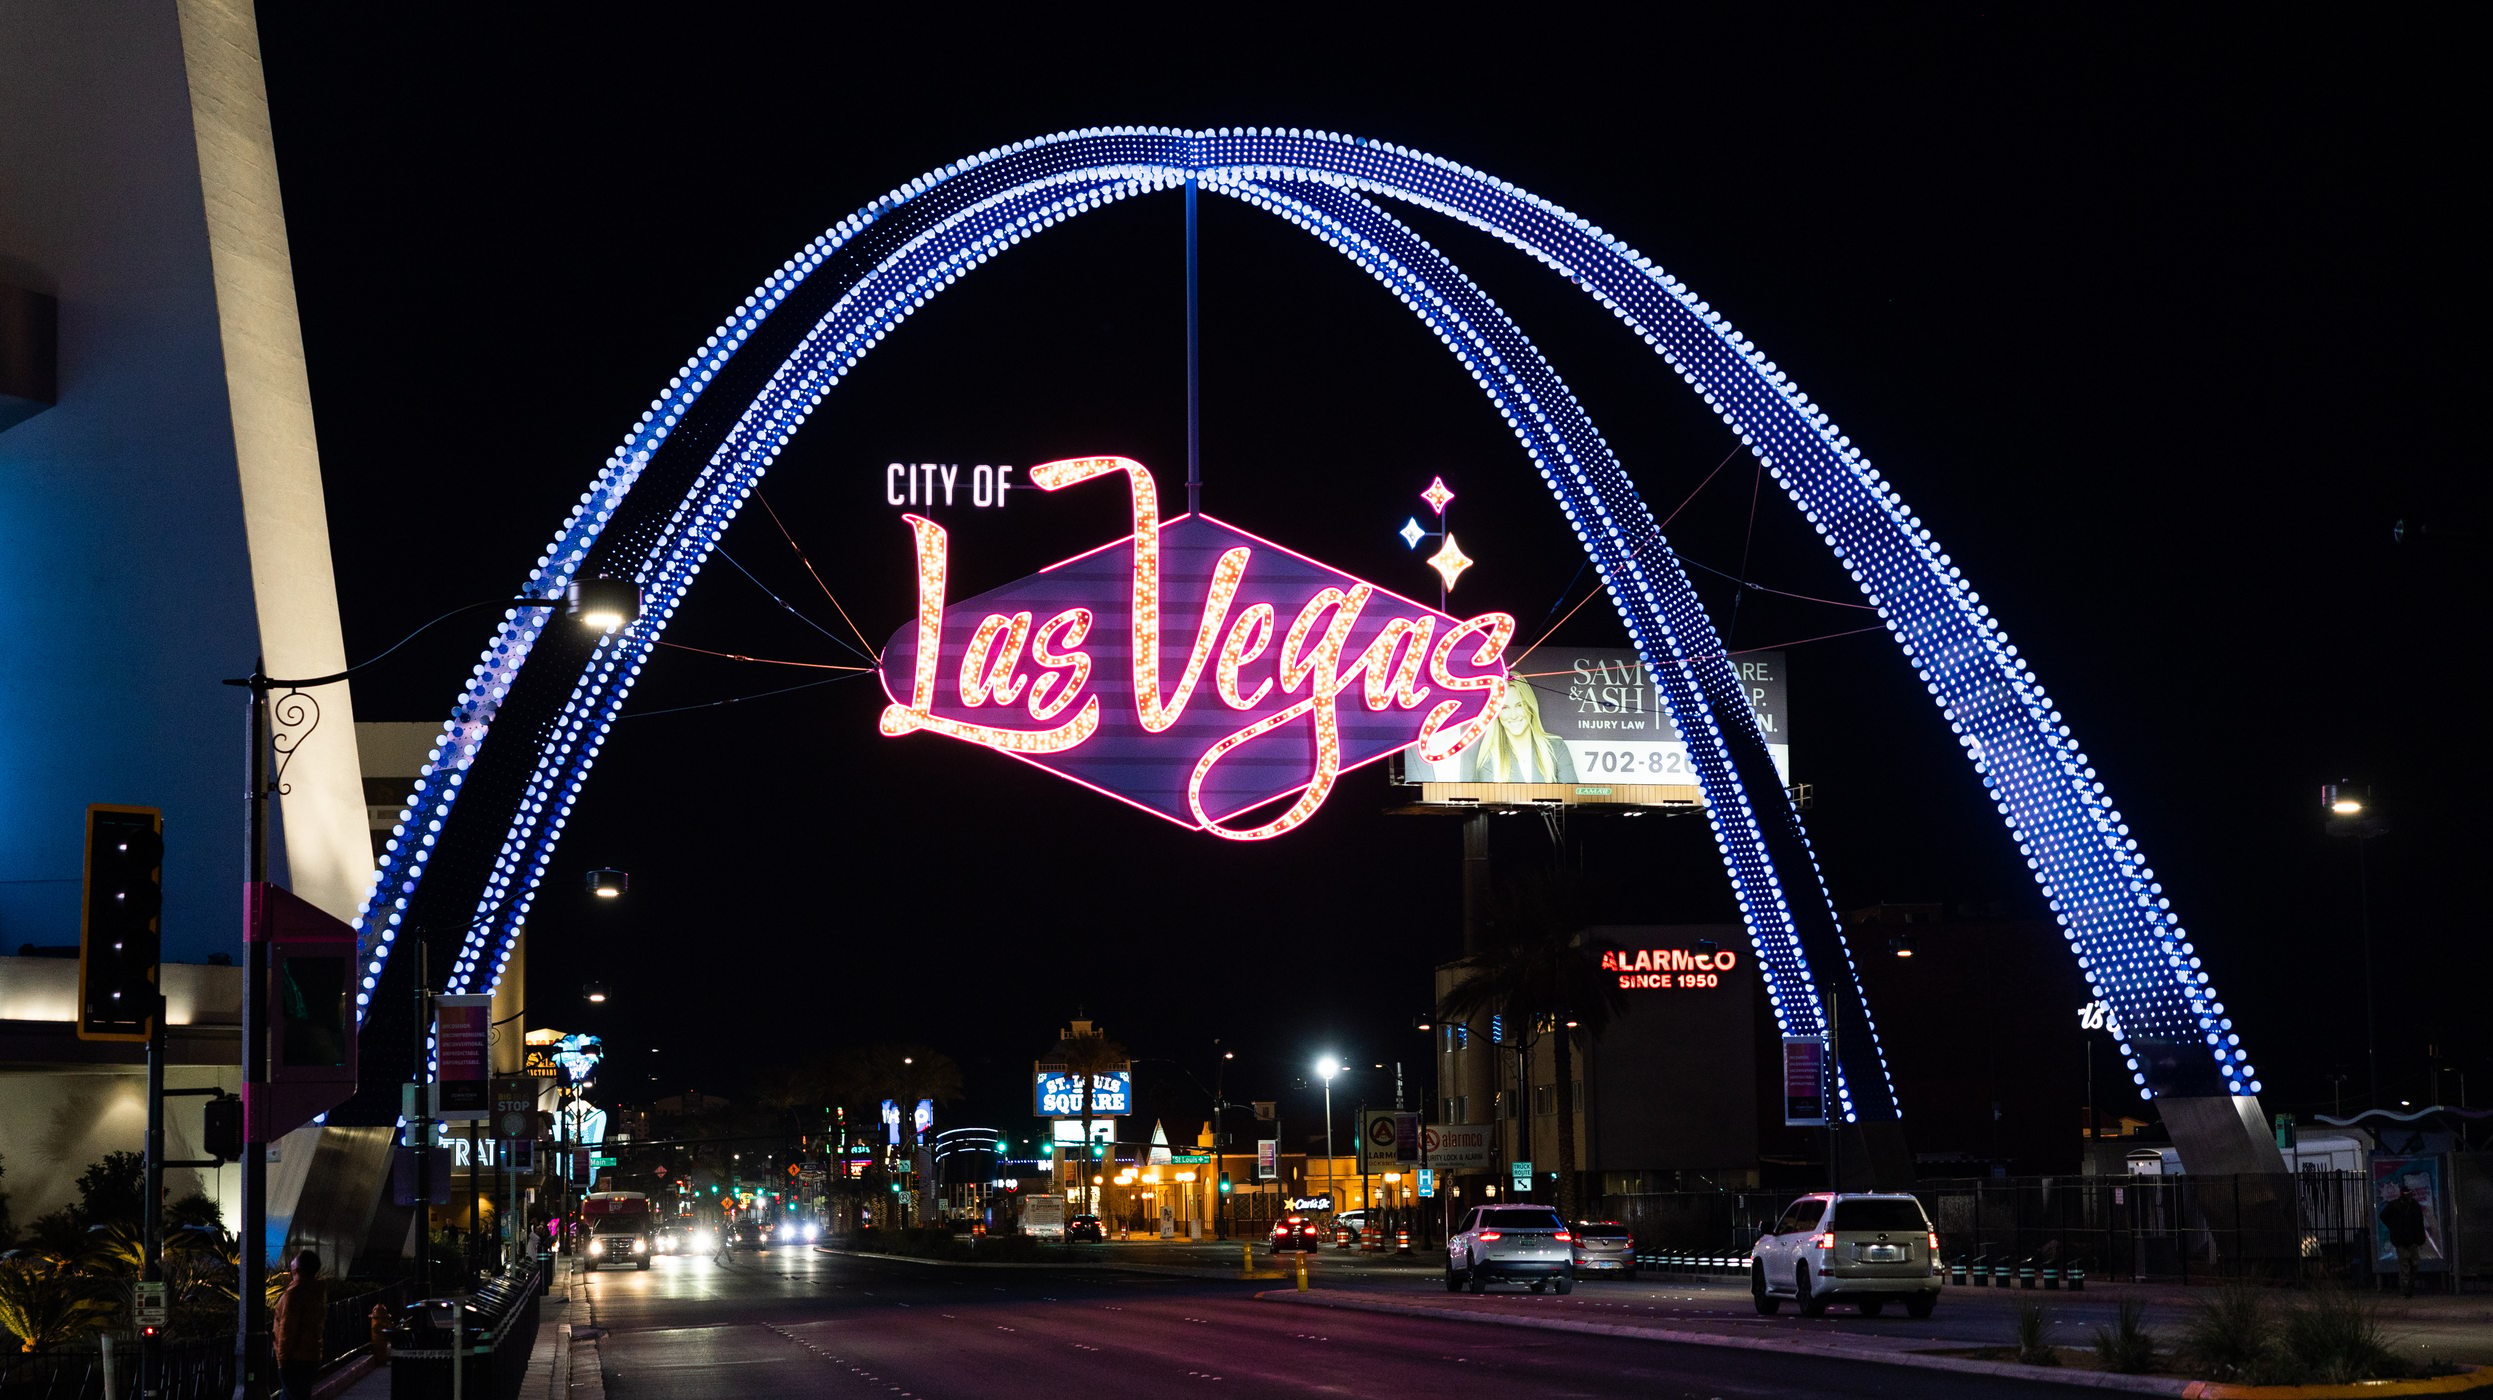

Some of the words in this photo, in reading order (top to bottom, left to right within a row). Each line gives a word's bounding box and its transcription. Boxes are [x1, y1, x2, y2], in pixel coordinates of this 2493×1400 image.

[886, 462, 958, 507] CITY
[972, 463, 1013, 507] OF
[879, 513, 1100, 753] Las
[1029, 455, 1517, 842] Vegas
[1572, 658, 1644, 686] SAM
[1578, 719, 1618, 730] INJURY
[1621, 719, 1645, 730] LAW
[1601, 949, 1736, 972] ALARMCO
[1619, 973, 1672, 989] SINCE
[1677, 974, 1718, 988] 1950
[1046, 1076, 1070, 1094] ST.
[497, 1101, 530, 1112] STOP
[1442, 1130, 1483, 1148] alarmco
[439, 1138, 496, 1166] TRAT
[590, 1158, 606, 1166] Main
[1419, 1170, 1432, 1185] H
[1295, 1198, 1318, 1210] Carl's
